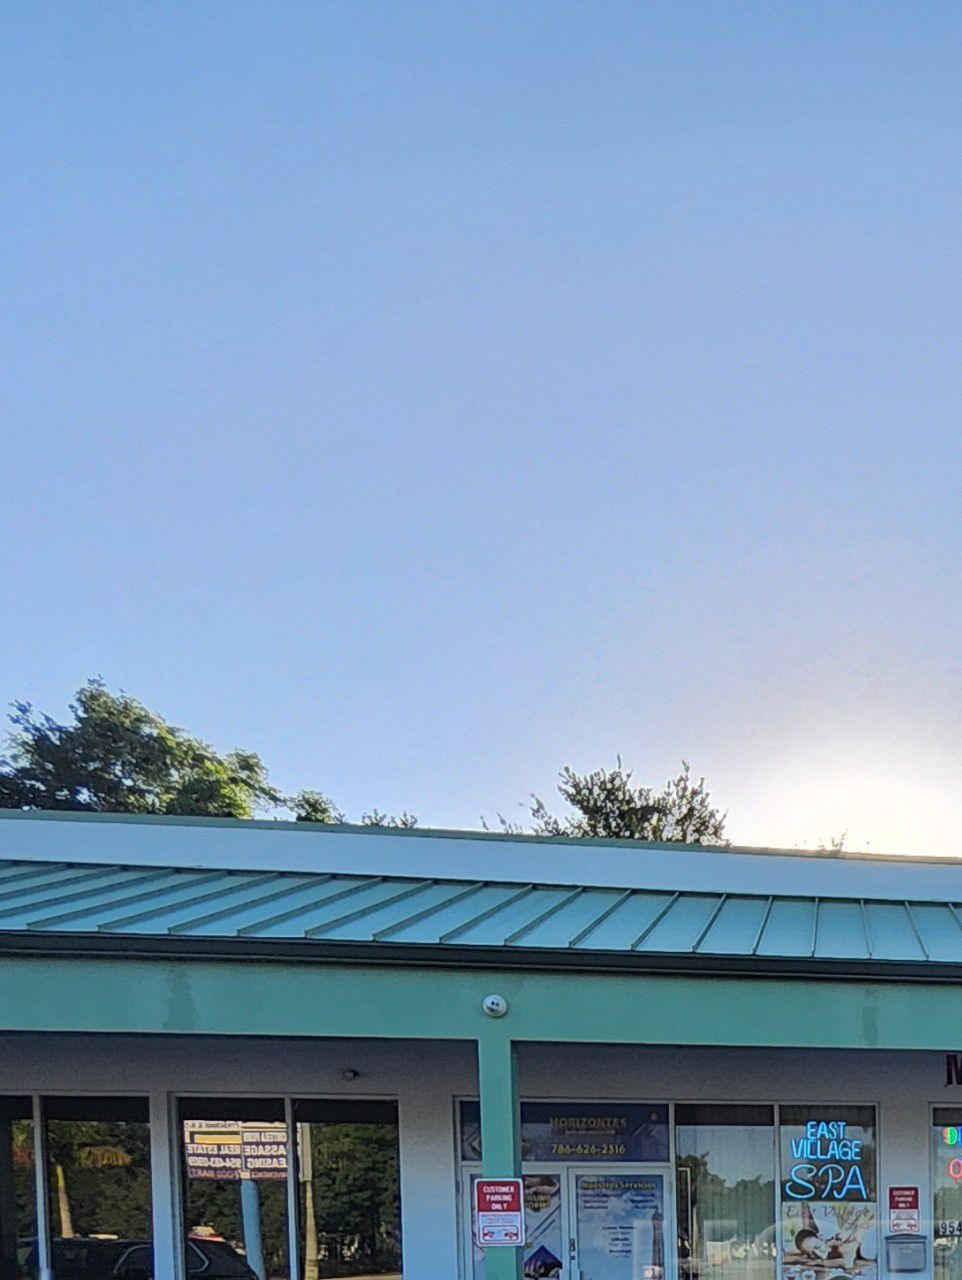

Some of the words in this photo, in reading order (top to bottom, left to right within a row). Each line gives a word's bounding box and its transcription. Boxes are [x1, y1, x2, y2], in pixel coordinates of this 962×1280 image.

[550, 1117, 627, 1129] HORIZONTES
[806, 1121, 847, 1140] EAST
[791, 1138, 863, 1161] VILLAGE
[784, 1163, 868, 1200] SPA
[483, 1186, 515, 1194] CUSTOMER
[486, 1194, 513, 1202] PARKING
